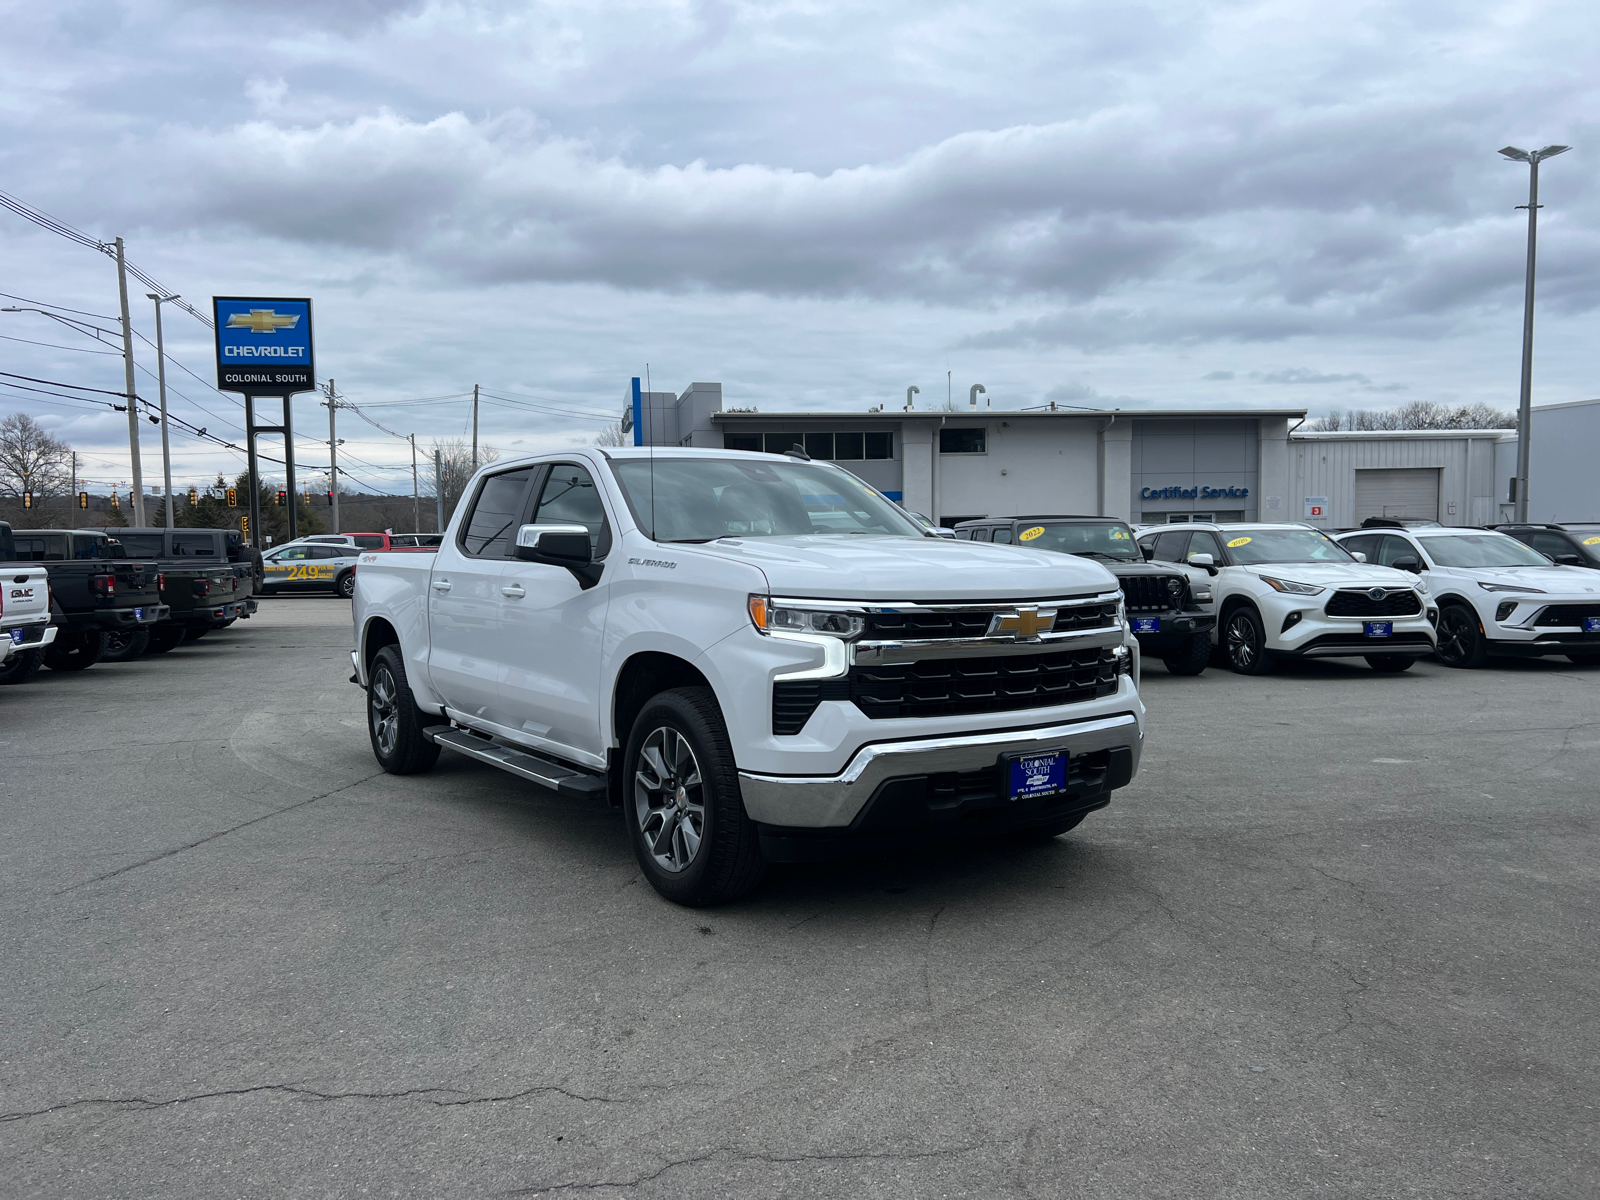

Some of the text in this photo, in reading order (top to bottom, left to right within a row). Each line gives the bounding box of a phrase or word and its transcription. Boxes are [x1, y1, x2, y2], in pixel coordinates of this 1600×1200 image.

[225, 346, 305, 357] CHEVROLET
[225, 374, 307, 383] COLONIAL SOUTH
[1141, 485, 1249, 499] Certified Service
[1025, 527, 1042, 540] 2022
[628, 557, 678, 569] SILVERADO
[11, 588, 34, 598] GMC
[1021, 758, 1056, 770] COLONIAL
[1025, 766, 1050, 777] SOUTH
